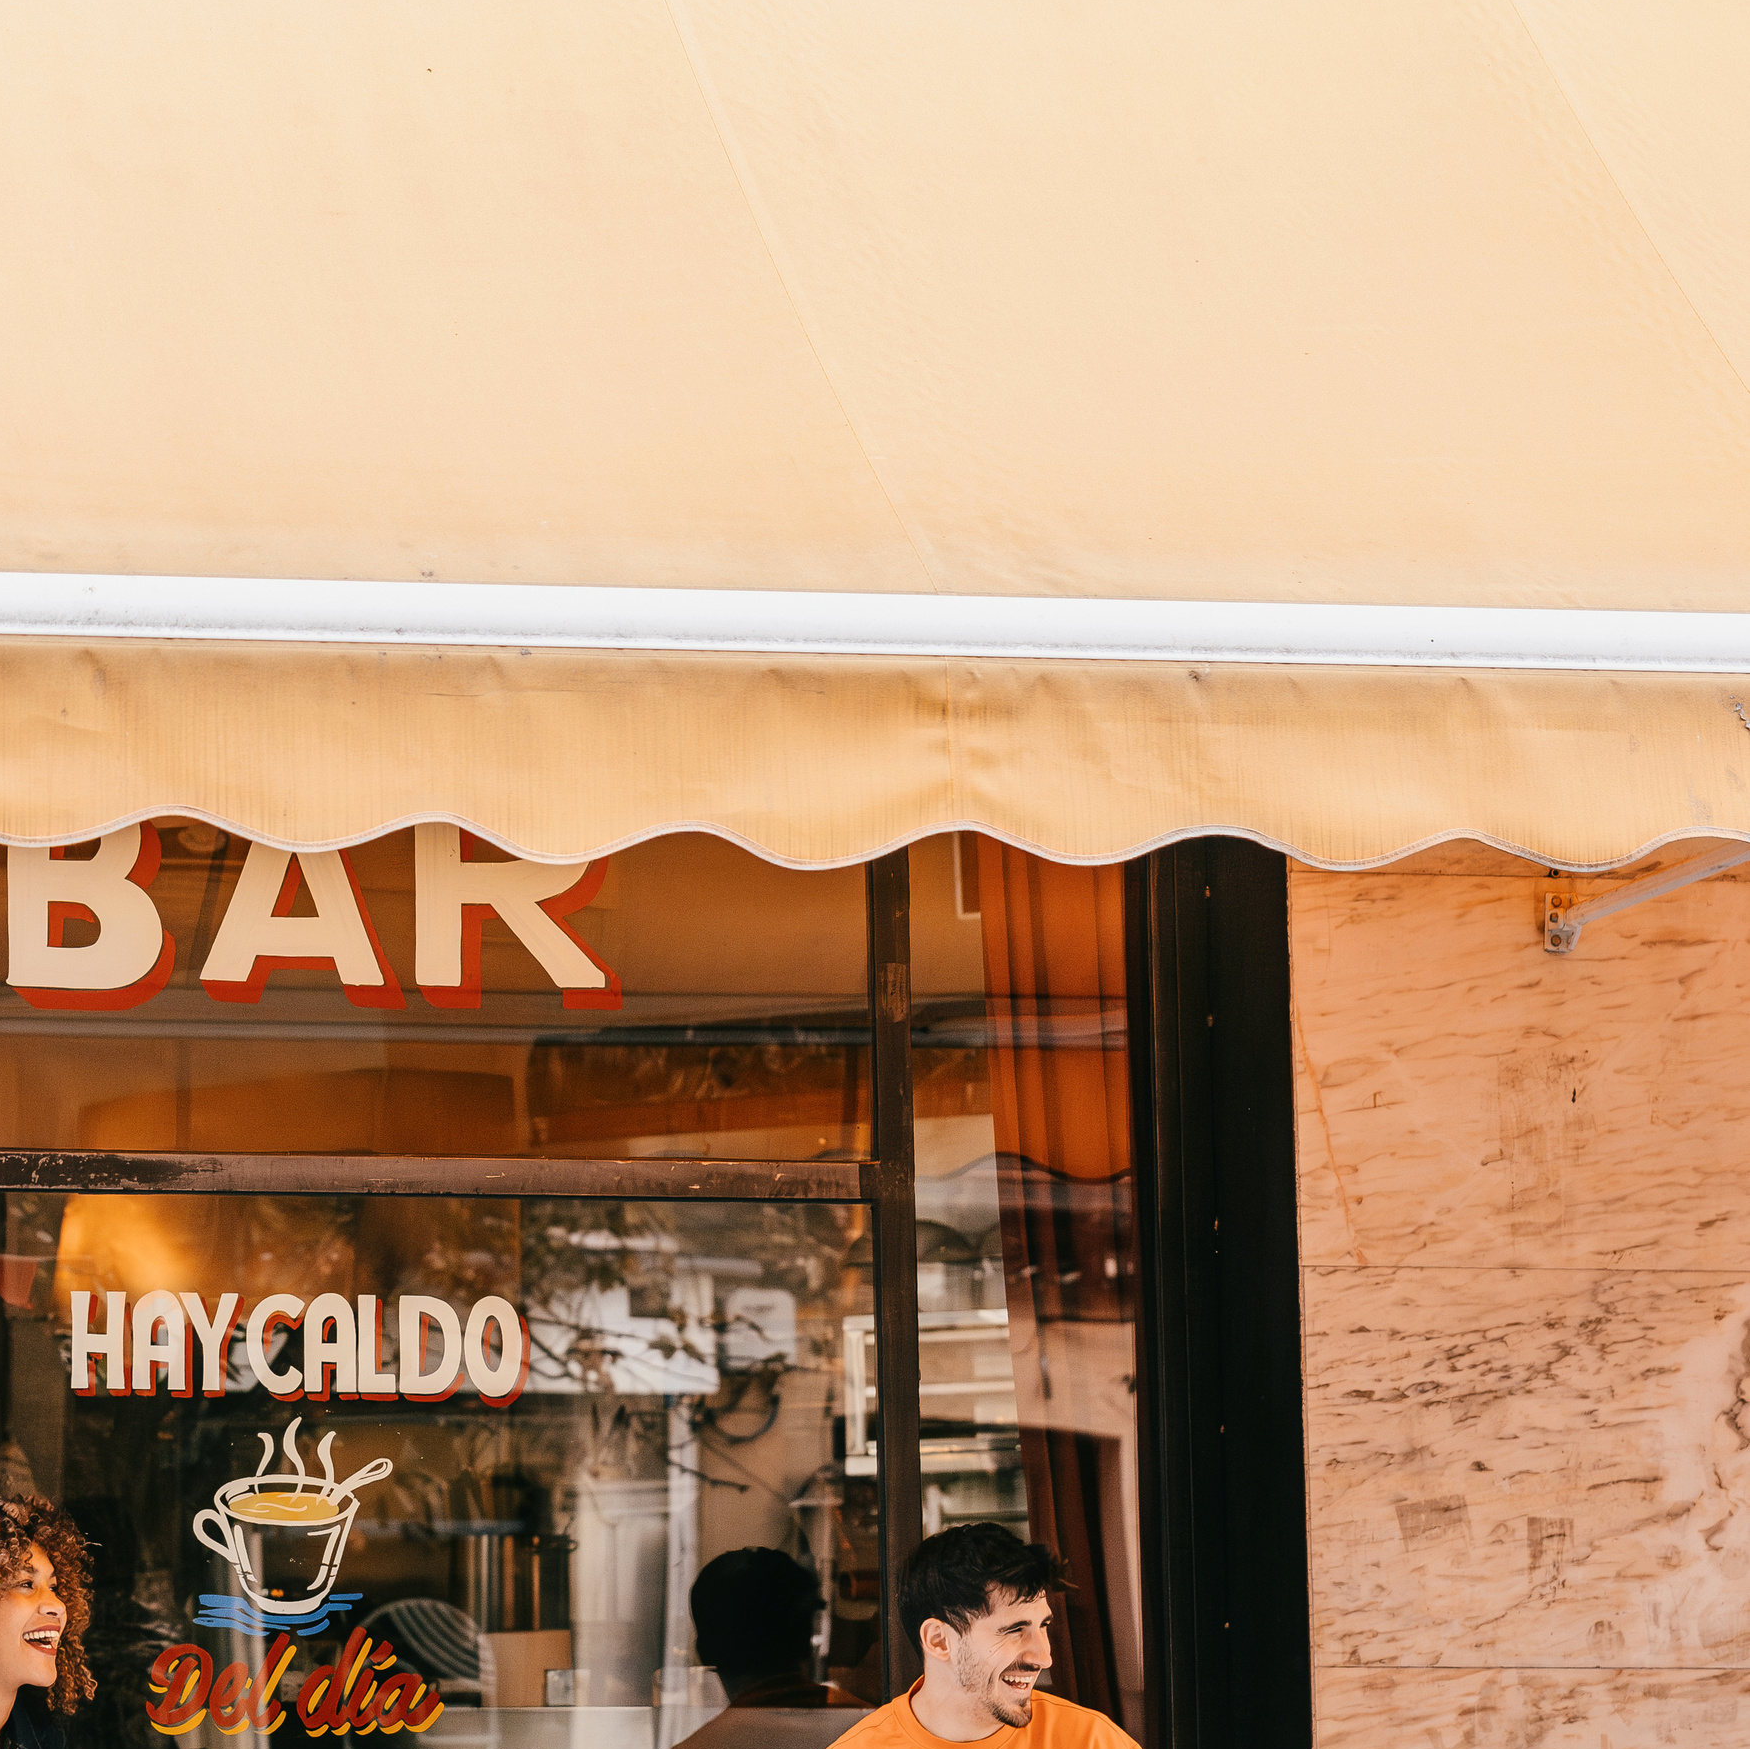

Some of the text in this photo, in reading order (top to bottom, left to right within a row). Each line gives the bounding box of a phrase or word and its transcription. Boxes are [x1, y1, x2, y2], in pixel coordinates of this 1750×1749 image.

[6, 821, 622, 1011] BAR
[70, 1289, 531, 1408] HAY CALDO
[146, 1626, 445, 1738] Del día
